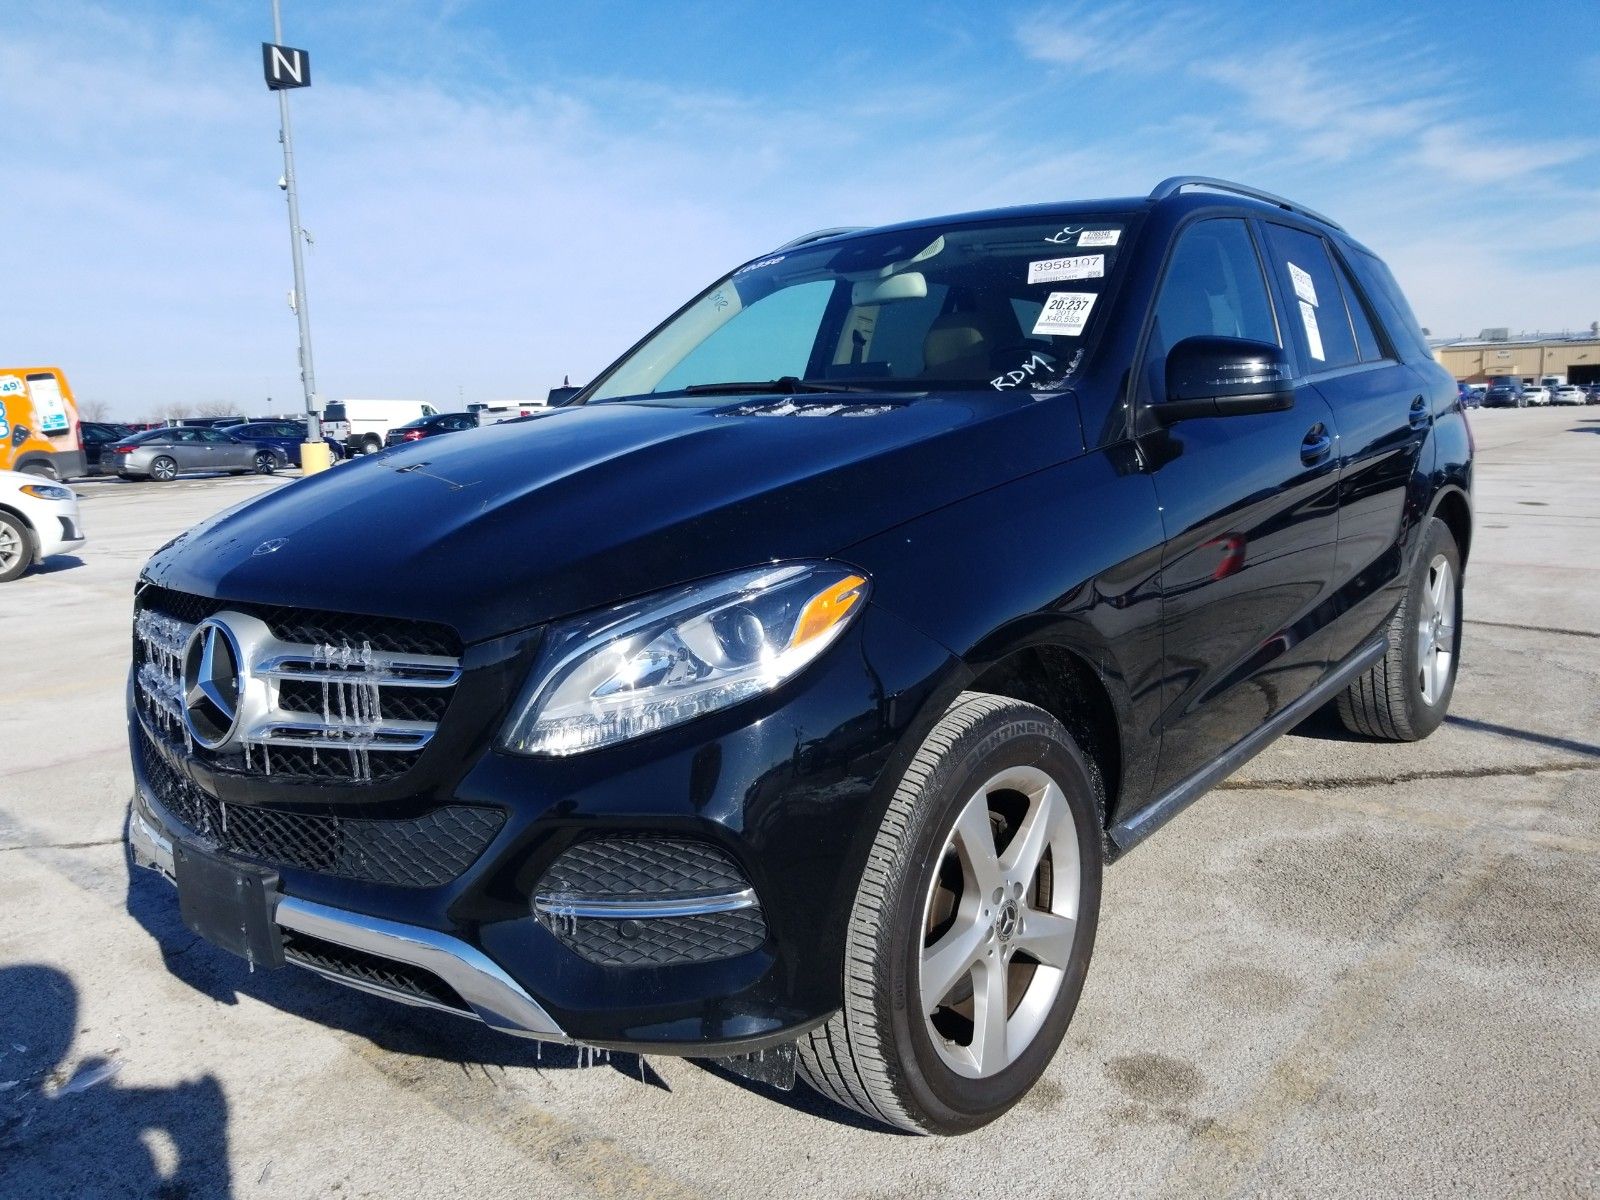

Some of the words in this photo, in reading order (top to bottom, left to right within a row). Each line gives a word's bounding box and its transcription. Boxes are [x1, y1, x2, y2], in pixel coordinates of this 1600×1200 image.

[272, 46, 302, 82] N
[1034, 257, 1100, 272] 3958107
[1049, 299, 1090, 311] 20:237
